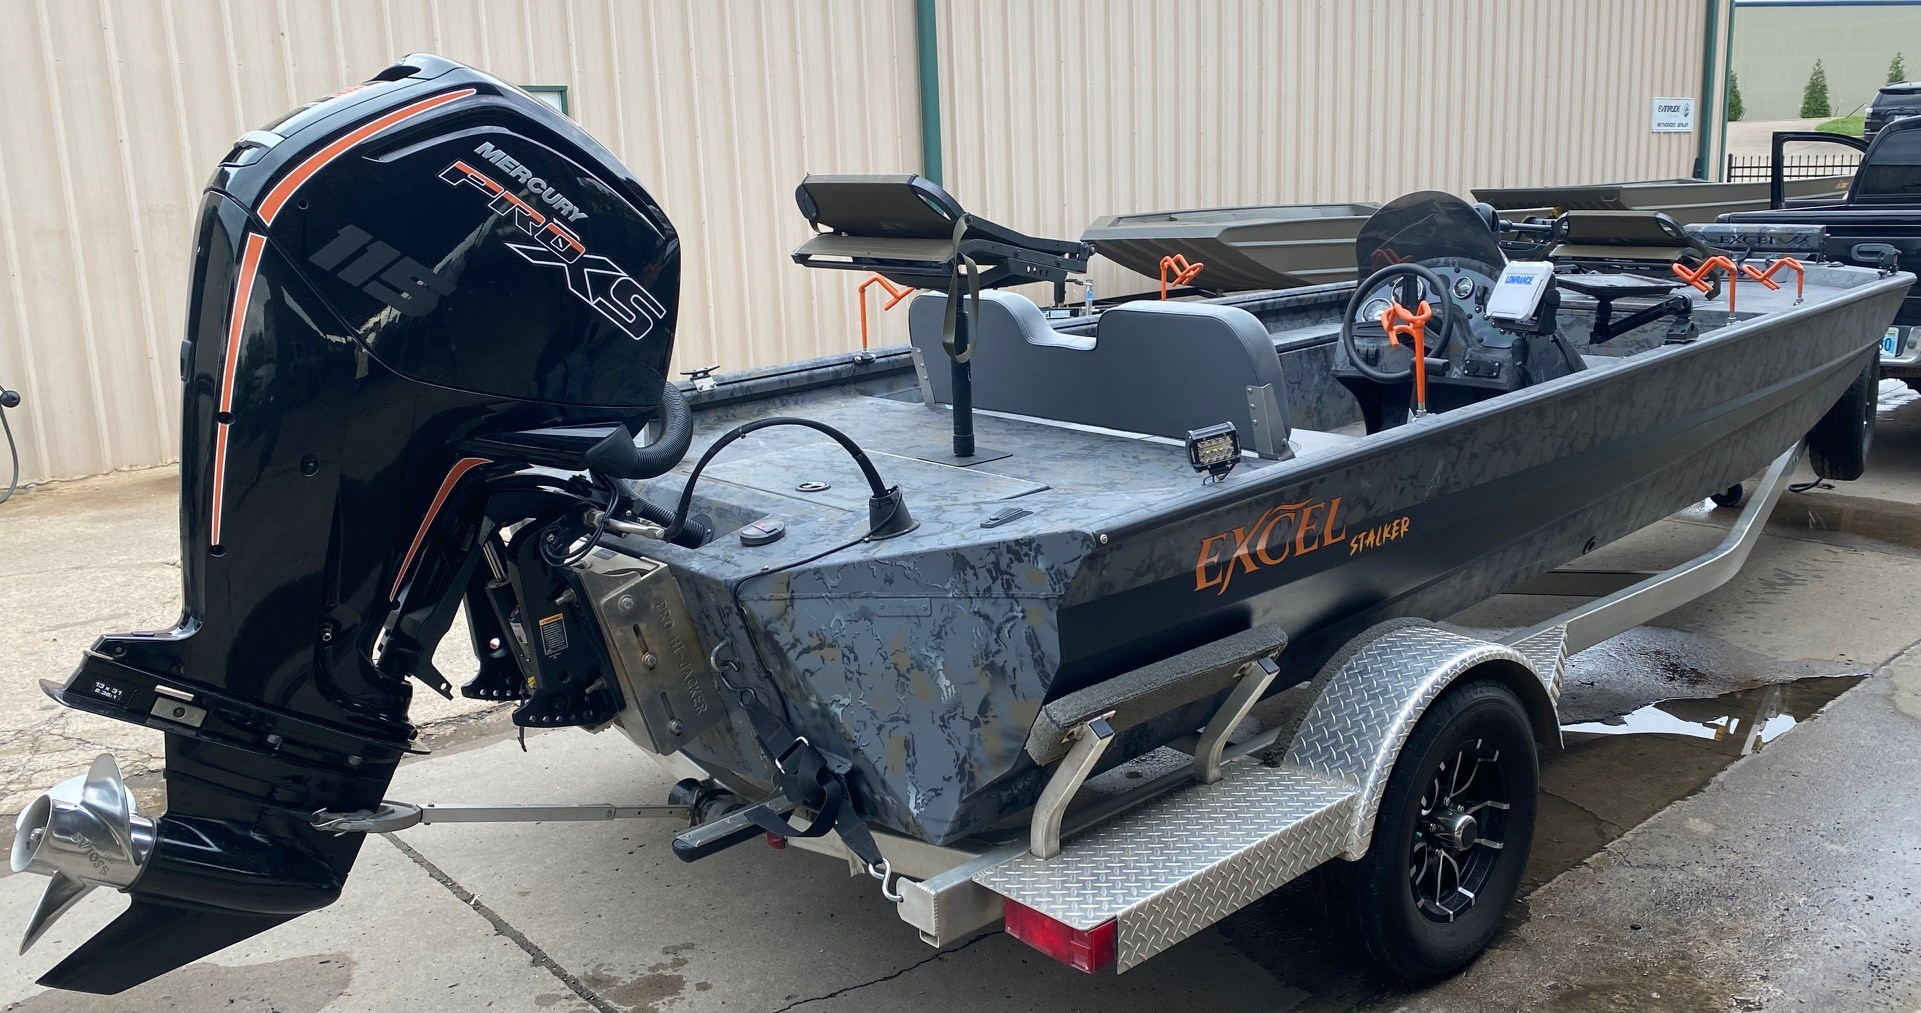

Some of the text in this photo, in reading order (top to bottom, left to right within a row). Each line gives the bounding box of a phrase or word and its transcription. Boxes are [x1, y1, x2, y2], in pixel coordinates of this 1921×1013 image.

[473, 141, 589, 223] MERCURY
[307, 224, 458, 318] 115
[437, 160, 667, 341] PRO XS
[1505, 275, 1534, 284] LOWRANCE
[1720, 235, 1779, 244] EXCEL
[1193, 496, 1411, 597] EXCEL STALKER
[654, 599, 708, 716] PRO HI-JACKER
